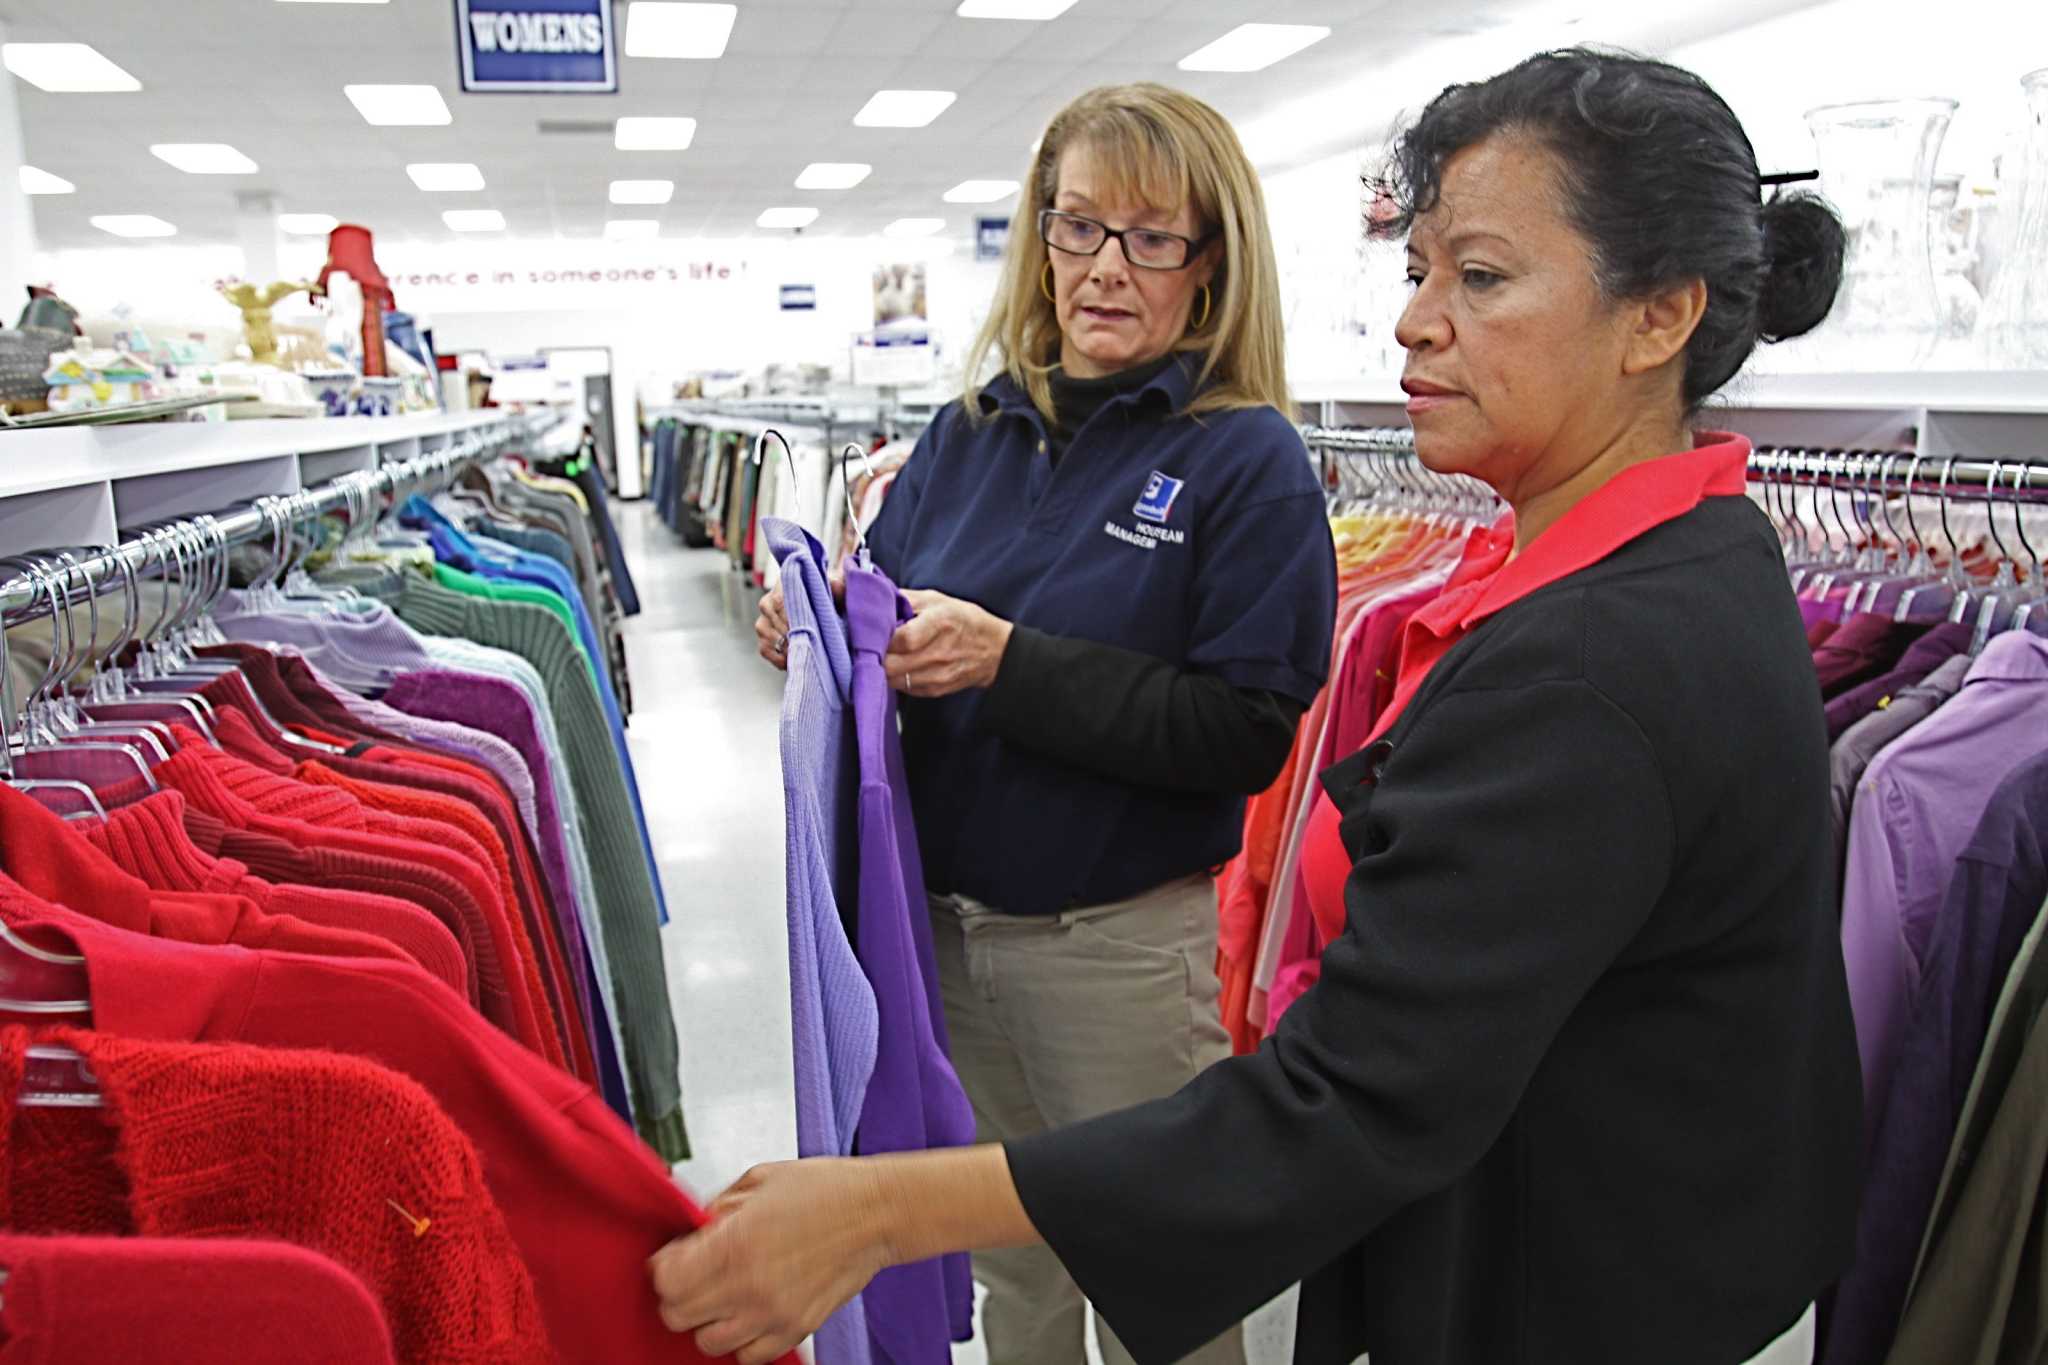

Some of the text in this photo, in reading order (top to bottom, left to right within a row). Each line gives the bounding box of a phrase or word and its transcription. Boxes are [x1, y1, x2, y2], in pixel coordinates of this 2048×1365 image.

[470, 12, 603, 53] WOMENS
[393, 271, 480, 286] rence
[492, 270, 515, 285] in
[528, 264, 678, 284] someone's
[1104, 521, 1157, 549] MANAGEM
